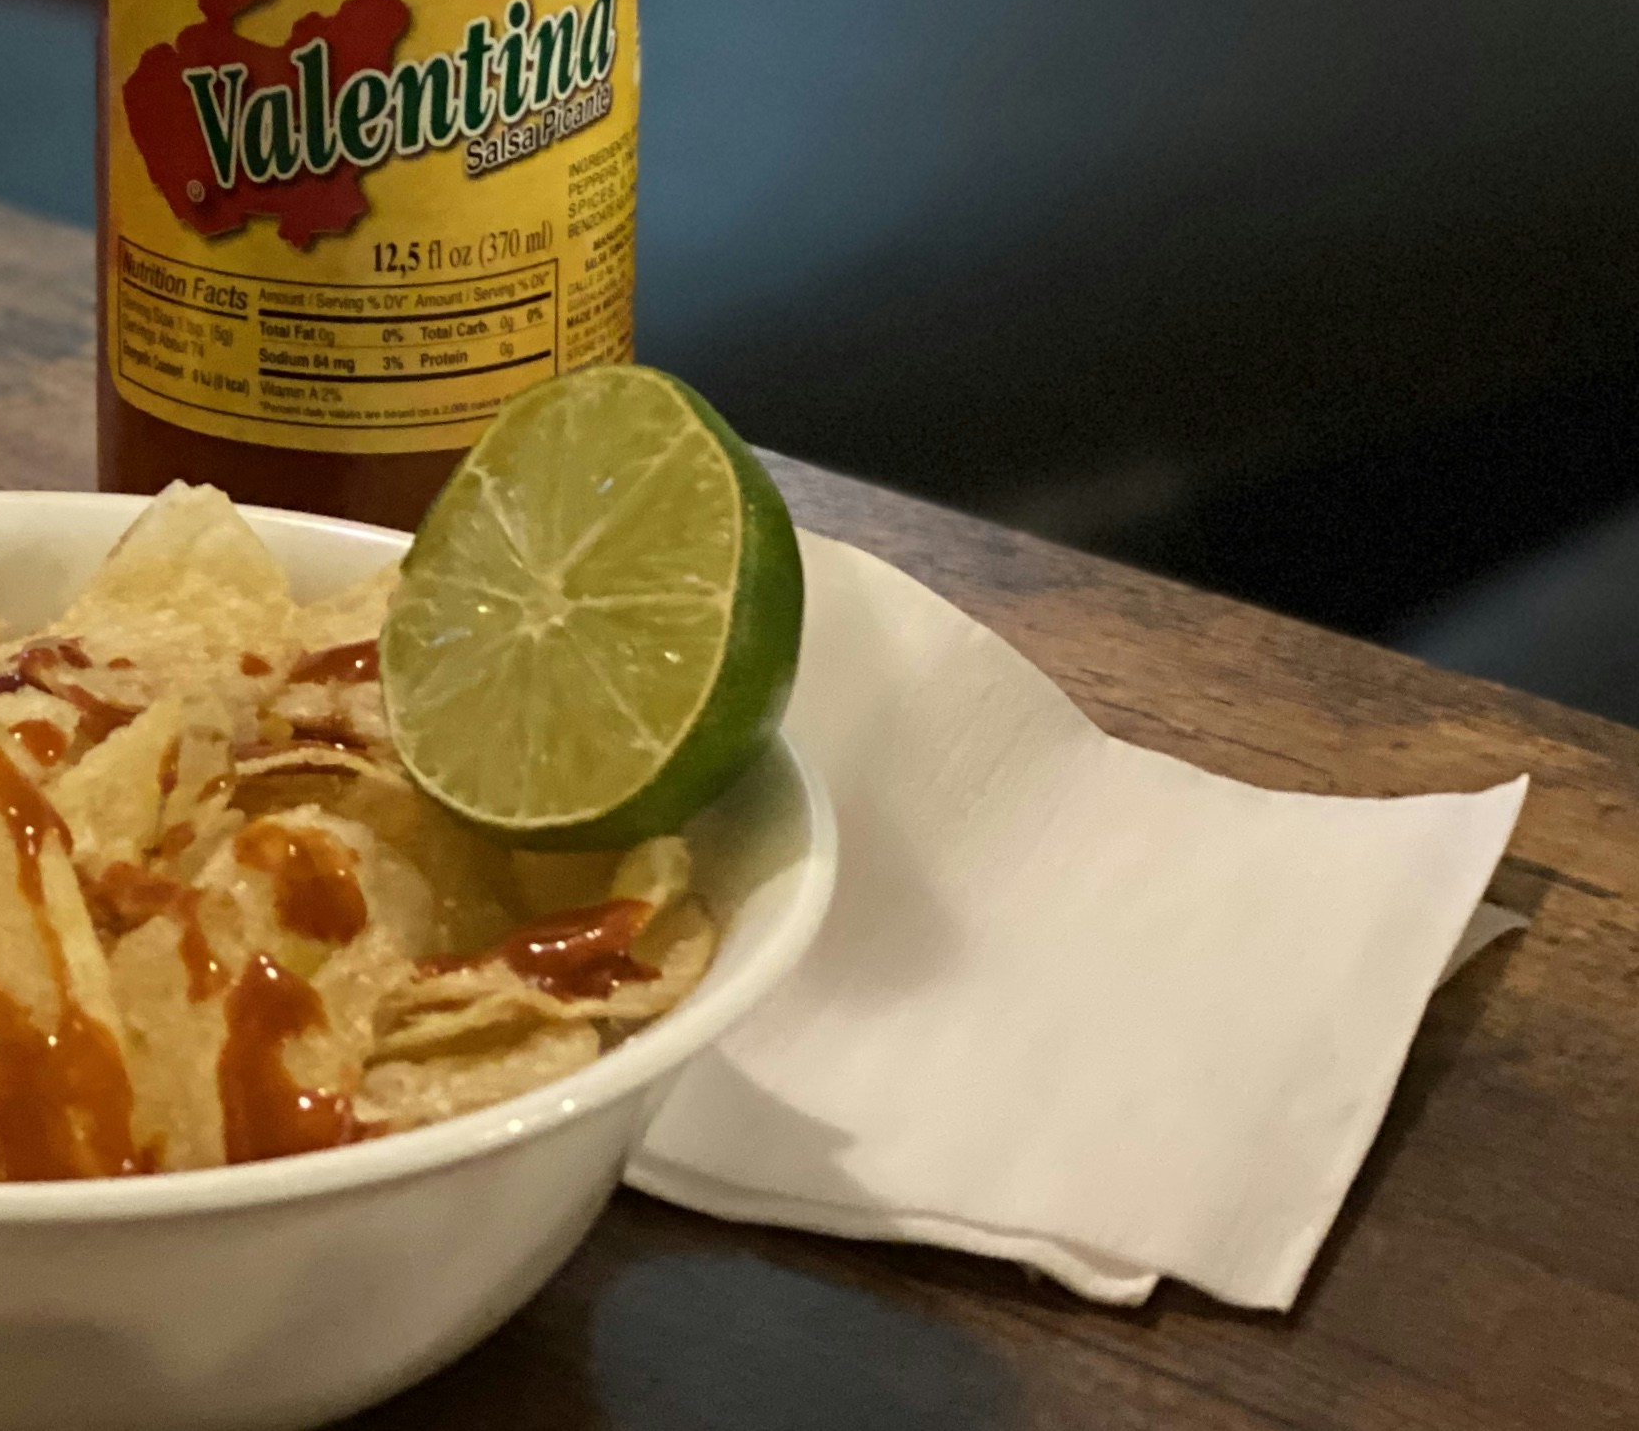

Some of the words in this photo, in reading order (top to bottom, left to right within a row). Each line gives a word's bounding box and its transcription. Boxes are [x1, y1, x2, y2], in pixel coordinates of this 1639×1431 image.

[466, 124, 537, 175] Salsa
[540, 81, 612, 146] Picante
[374, 241, 421, 278] 12,5
[428, 240, 442, 269] fl
[449, 245, 473, 268] oz
[479, 228, 520, 268] (370
[525, 220, 553, 254] ml)
[122, 250, 187, 297] Nutrition
[192, 276, 249, 310] Facts
[259, 320, 291, 338] Total
[294, 324, 316, 341] Fat
[419, 324, 453, 341] Total
[259, 347, 310, 368] Sodium
[333, 357, 356, 374] mg
[420, 349, 469, 368] Protein
